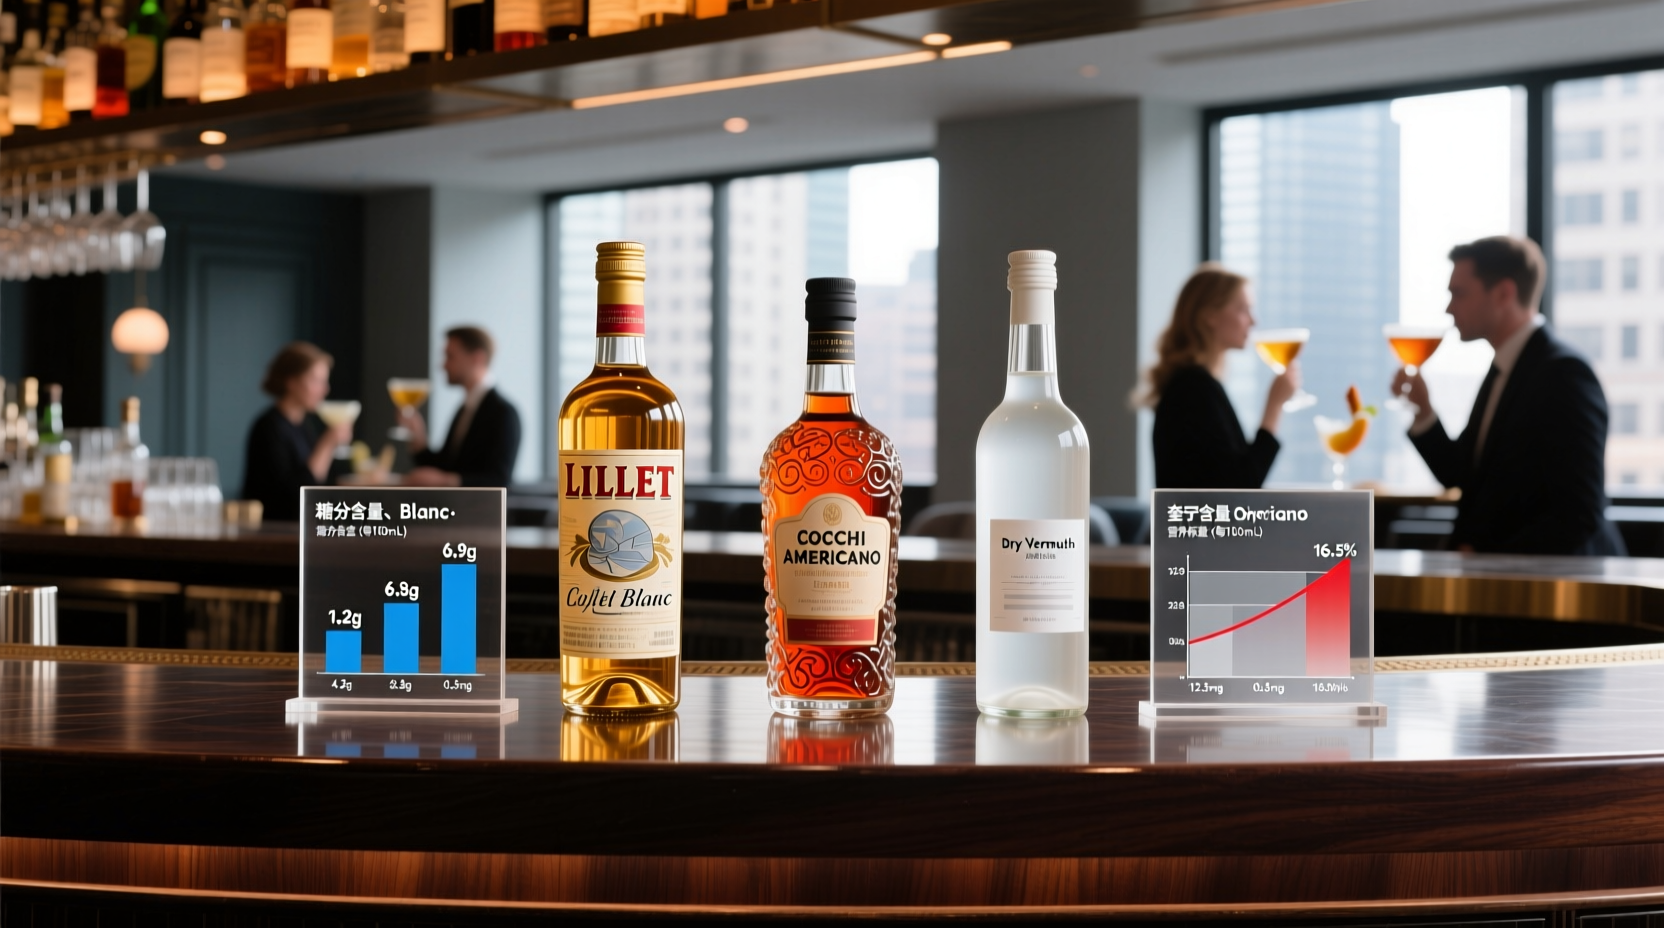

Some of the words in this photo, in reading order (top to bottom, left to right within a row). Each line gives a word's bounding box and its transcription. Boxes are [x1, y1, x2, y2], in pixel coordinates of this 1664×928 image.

[565, 463, 674, 499] LILLET
[797, 530, 865, 546] COCCHI
[1002, 537, 1022, 552] Dry
[442, 542, 477, 562] 6.9g
[783, 549, 881, 565] AMERICANO
[1313, 543, 1357, 558] 16.5%
[620, 588, 672, 607] Blanc
[328, 609, 362, 629] 1.2g
